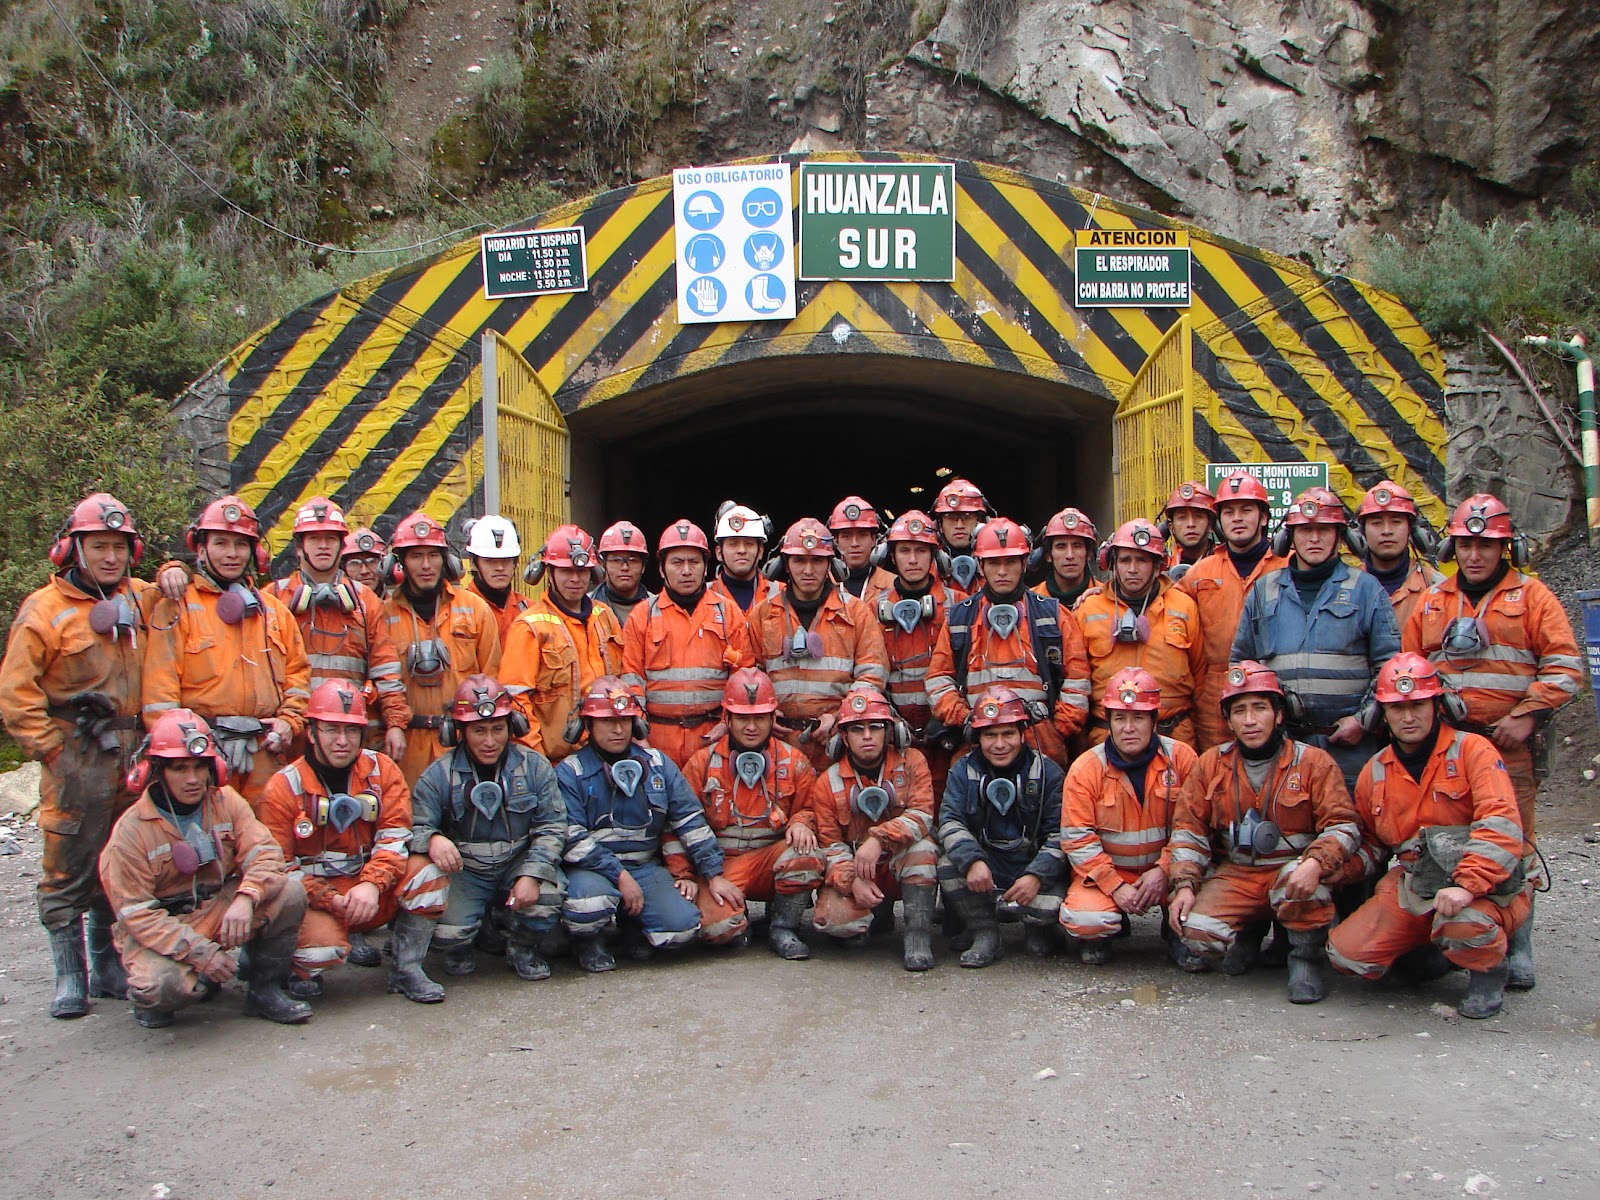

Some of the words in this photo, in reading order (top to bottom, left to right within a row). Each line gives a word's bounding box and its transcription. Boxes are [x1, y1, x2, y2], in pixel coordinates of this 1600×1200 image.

[678, 173, 701, 185] USO
[705, 168, 784, 184] OBLIGATORIO
[806, 174, 948, 215] HUANZALA
[488, 236, 526, 252] HORARIO
[528, 236, 539, 248] DE
[541, 233, 578, 248] DISPARO
[1090, 231, 1176, 245] ATENCION
[498, 252, 512, 262] DIA
[532, 249, 553, 259] 11.50
[556, 249, 570, 257] a.m.
[839, 228, 917, 269] SUR
[535, 259, 554, 269] 5.50
[556, 259, 571, 269] p.m.
[1096, 256, 1108, 271] EL
[1110, 256, 1169, 271] RESPIRADOR
[533, 269, 555, 280] 11.50
[557, 269, 571, 279] p.m.
[537, 279, 555, 289] 5.50
[558, 279, 572, 287] a.m.
[1079, 283, 1097, 299] CON
[1099, 283, 1129, 298] BARBA
[1131, 283, 1143, 298] NO
[1146, 283, 1188, 299] PROTEJE
[1248, 466, 1261, 477] DE
[1263, 466, 1319, 477] MONITOREO
[1262, 478, 1290, 489] AGUA
